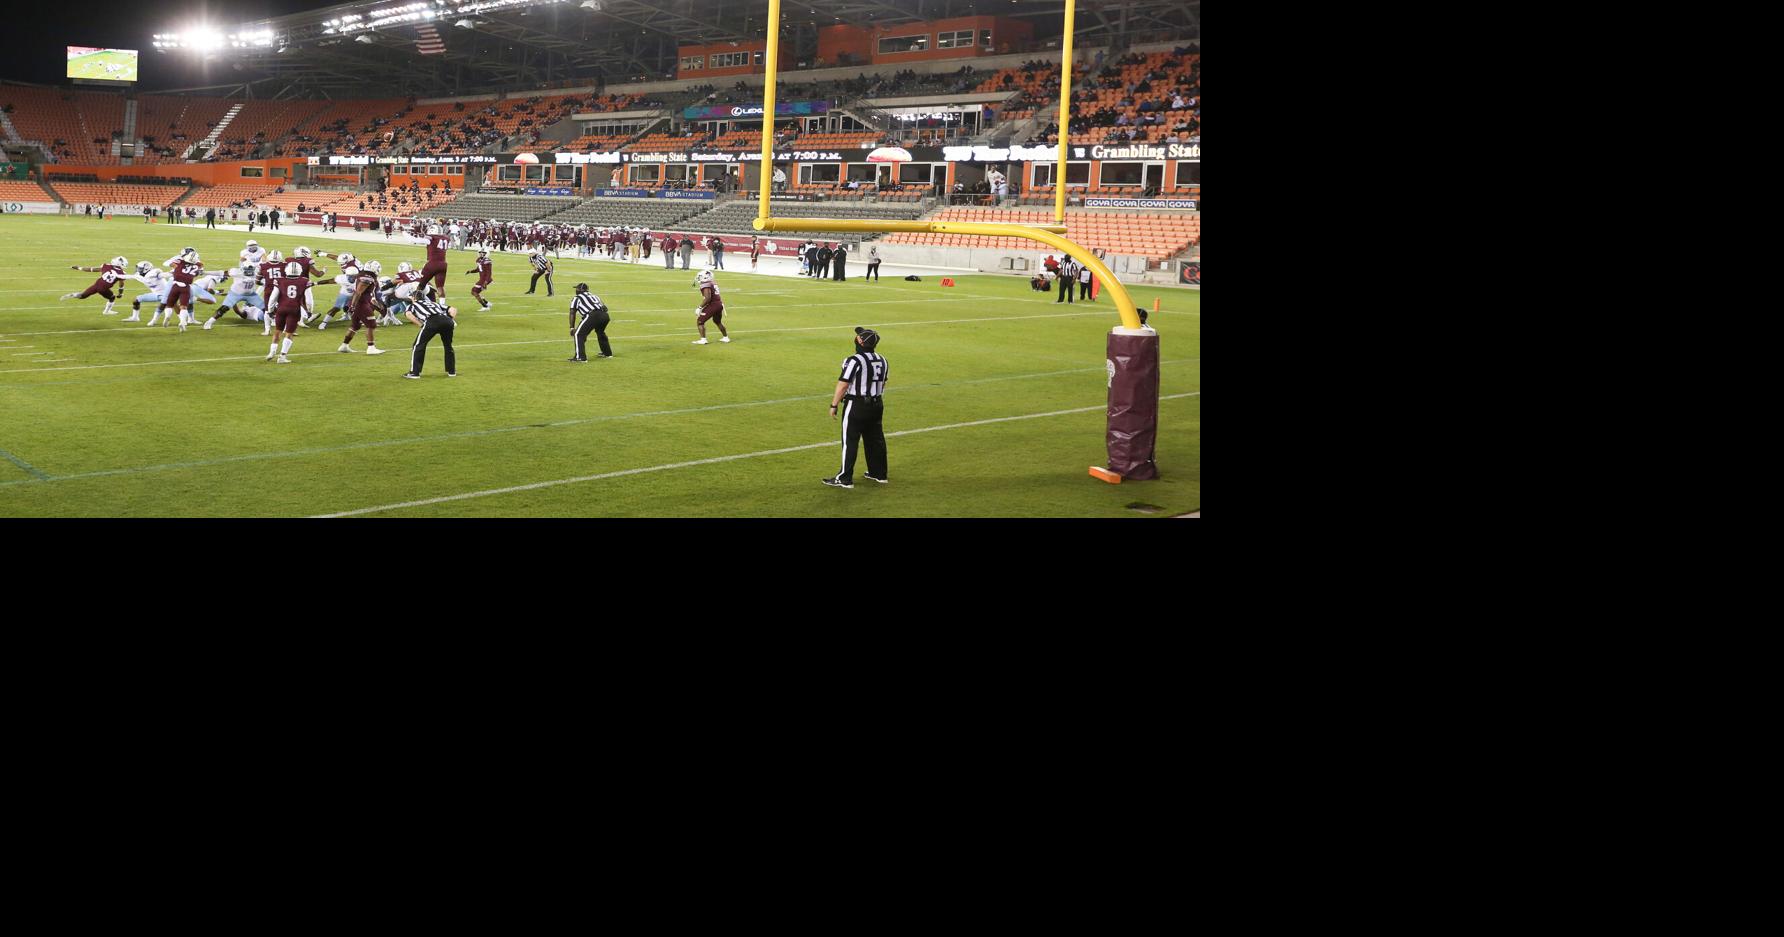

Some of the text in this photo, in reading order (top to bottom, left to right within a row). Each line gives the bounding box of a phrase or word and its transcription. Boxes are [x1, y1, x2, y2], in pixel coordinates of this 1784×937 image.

[631, 152, 668, 163] Grambling
[668, 152, 688, 162] State
[793, 152, 818, 160] 7:00
[1091, 145, 1166, 159] Grambling
[1168, 144, 1200, 158] Stat
[1086, 199, 1111, 207] GOYA
[1112, 200, 1138, 208] GOYA
[1140, 200, 1166, 208] GOYA
[437, 239, 448, 250] 41
[181, 264, 198, 276] 32
[266, 267, 282, 279] 15
[406, 271, 421, 282] 54
[287, 285, 297, 299] 6
[871, 361, 883, 380] F
